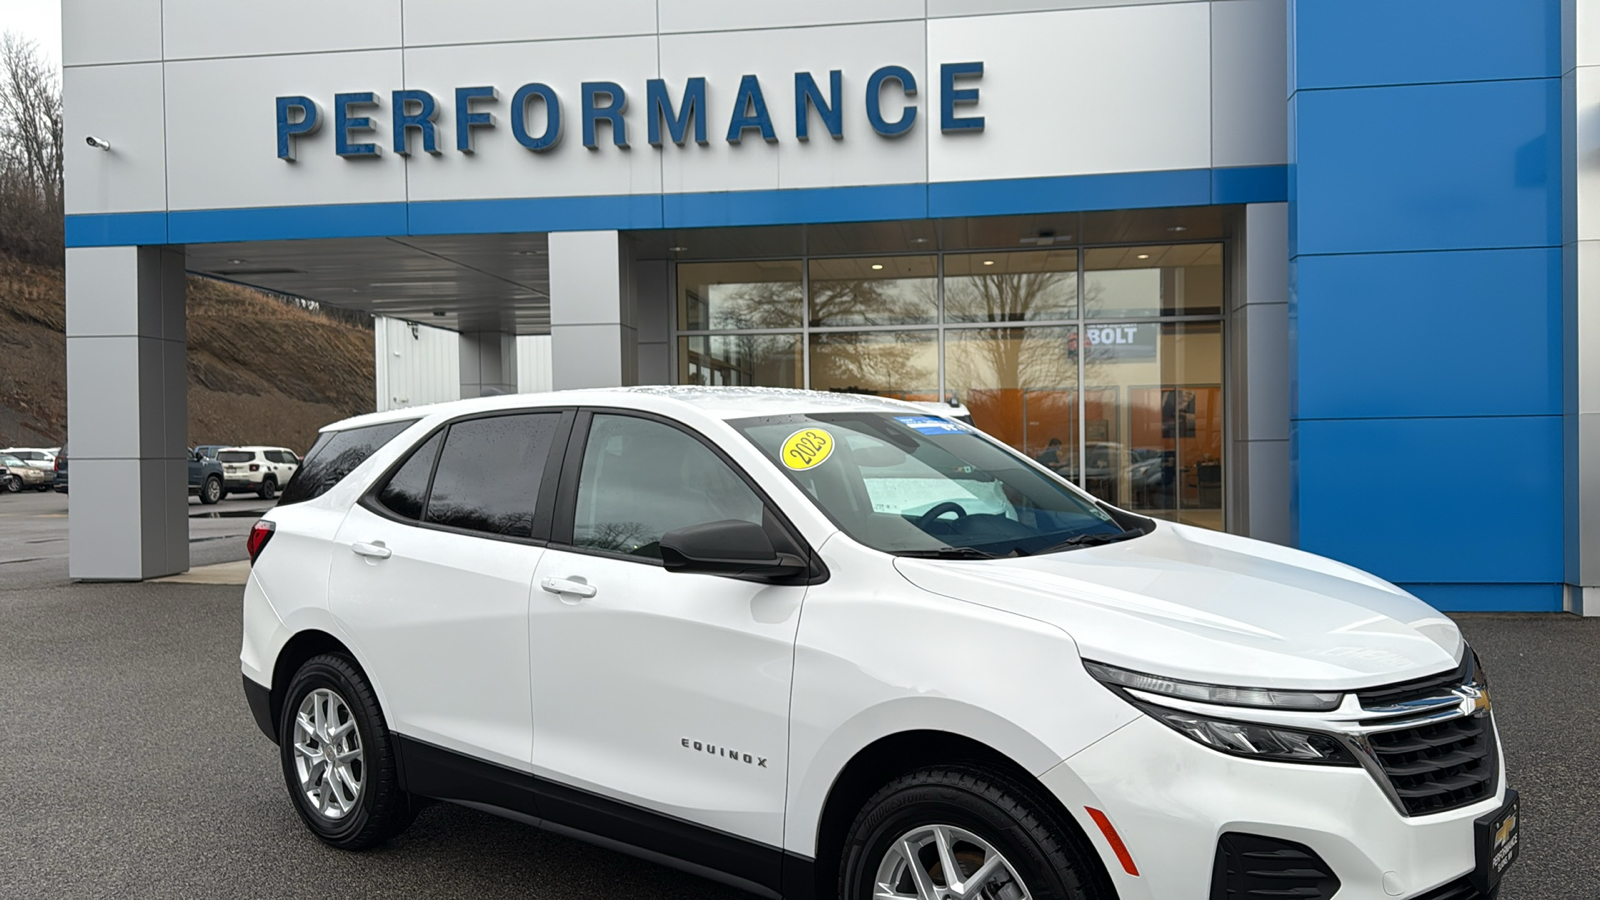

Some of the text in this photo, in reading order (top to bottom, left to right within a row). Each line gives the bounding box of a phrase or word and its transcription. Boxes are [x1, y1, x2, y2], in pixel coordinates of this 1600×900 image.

[275, 61, 985, 160] PERFORMANCE
[1087, 328, 1137, 345] BOLT
[790, 431, 827, 465] 2023
[681, 738, 767, 768] EQUINOX
